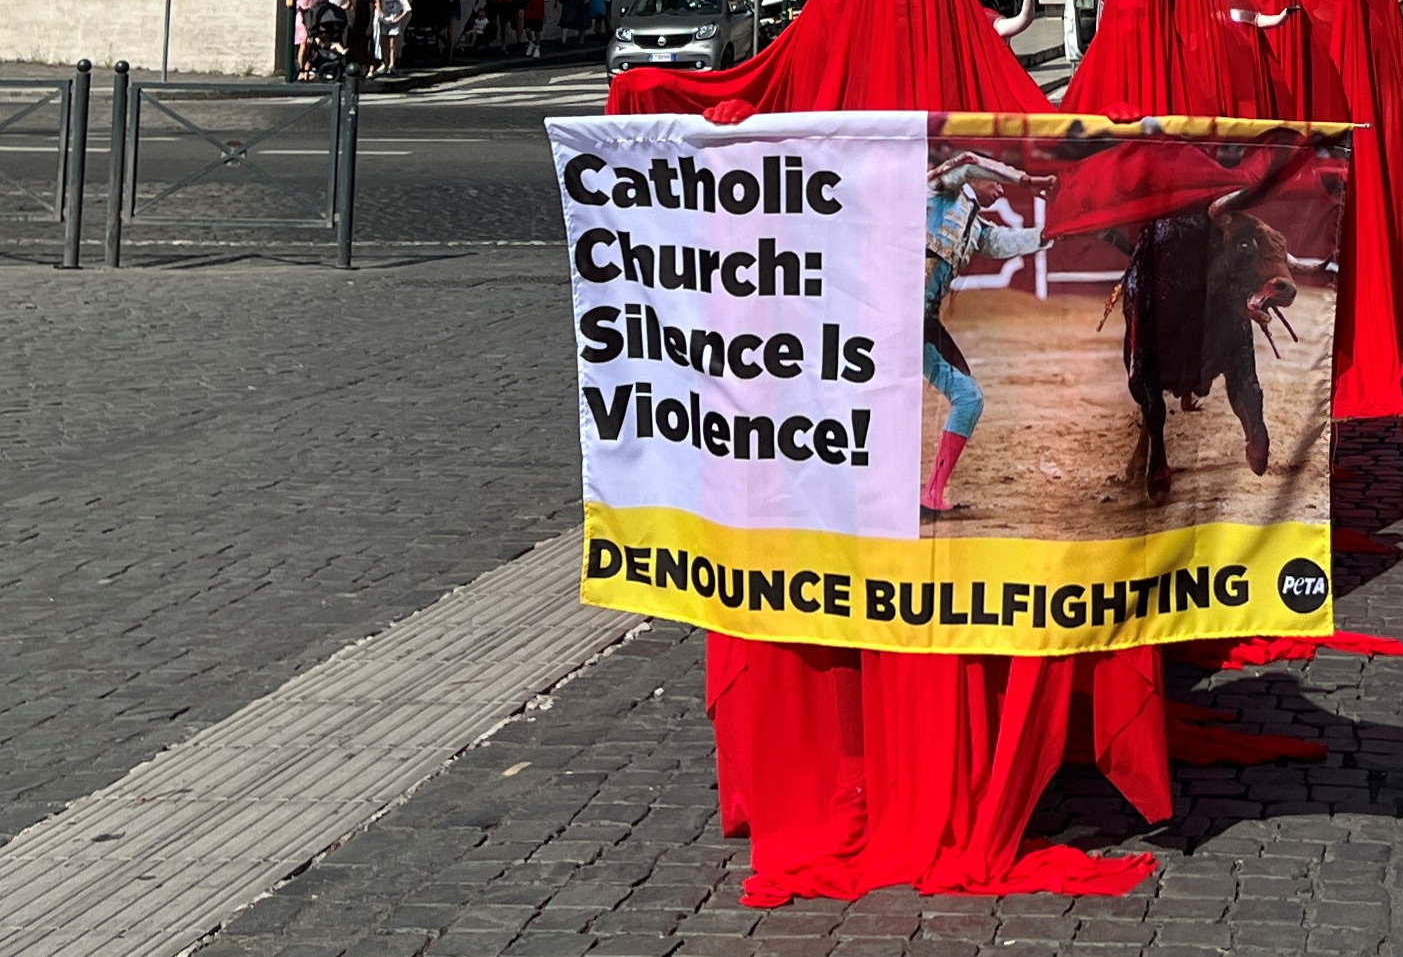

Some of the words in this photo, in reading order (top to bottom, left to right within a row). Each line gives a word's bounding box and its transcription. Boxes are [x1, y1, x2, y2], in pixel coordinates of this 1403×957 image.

[563, 153, 843, 215] Catholic
[574, 227, 822, 297] Church:
[579, 303, 804, 380] Silence
[821, 323, 876, 383] Is
[582, 382, 871, 466] Violence!
[587, 538, 851, 618] DENOUNCE
[865, 564, 1249, 630] BULLFIGHTING
